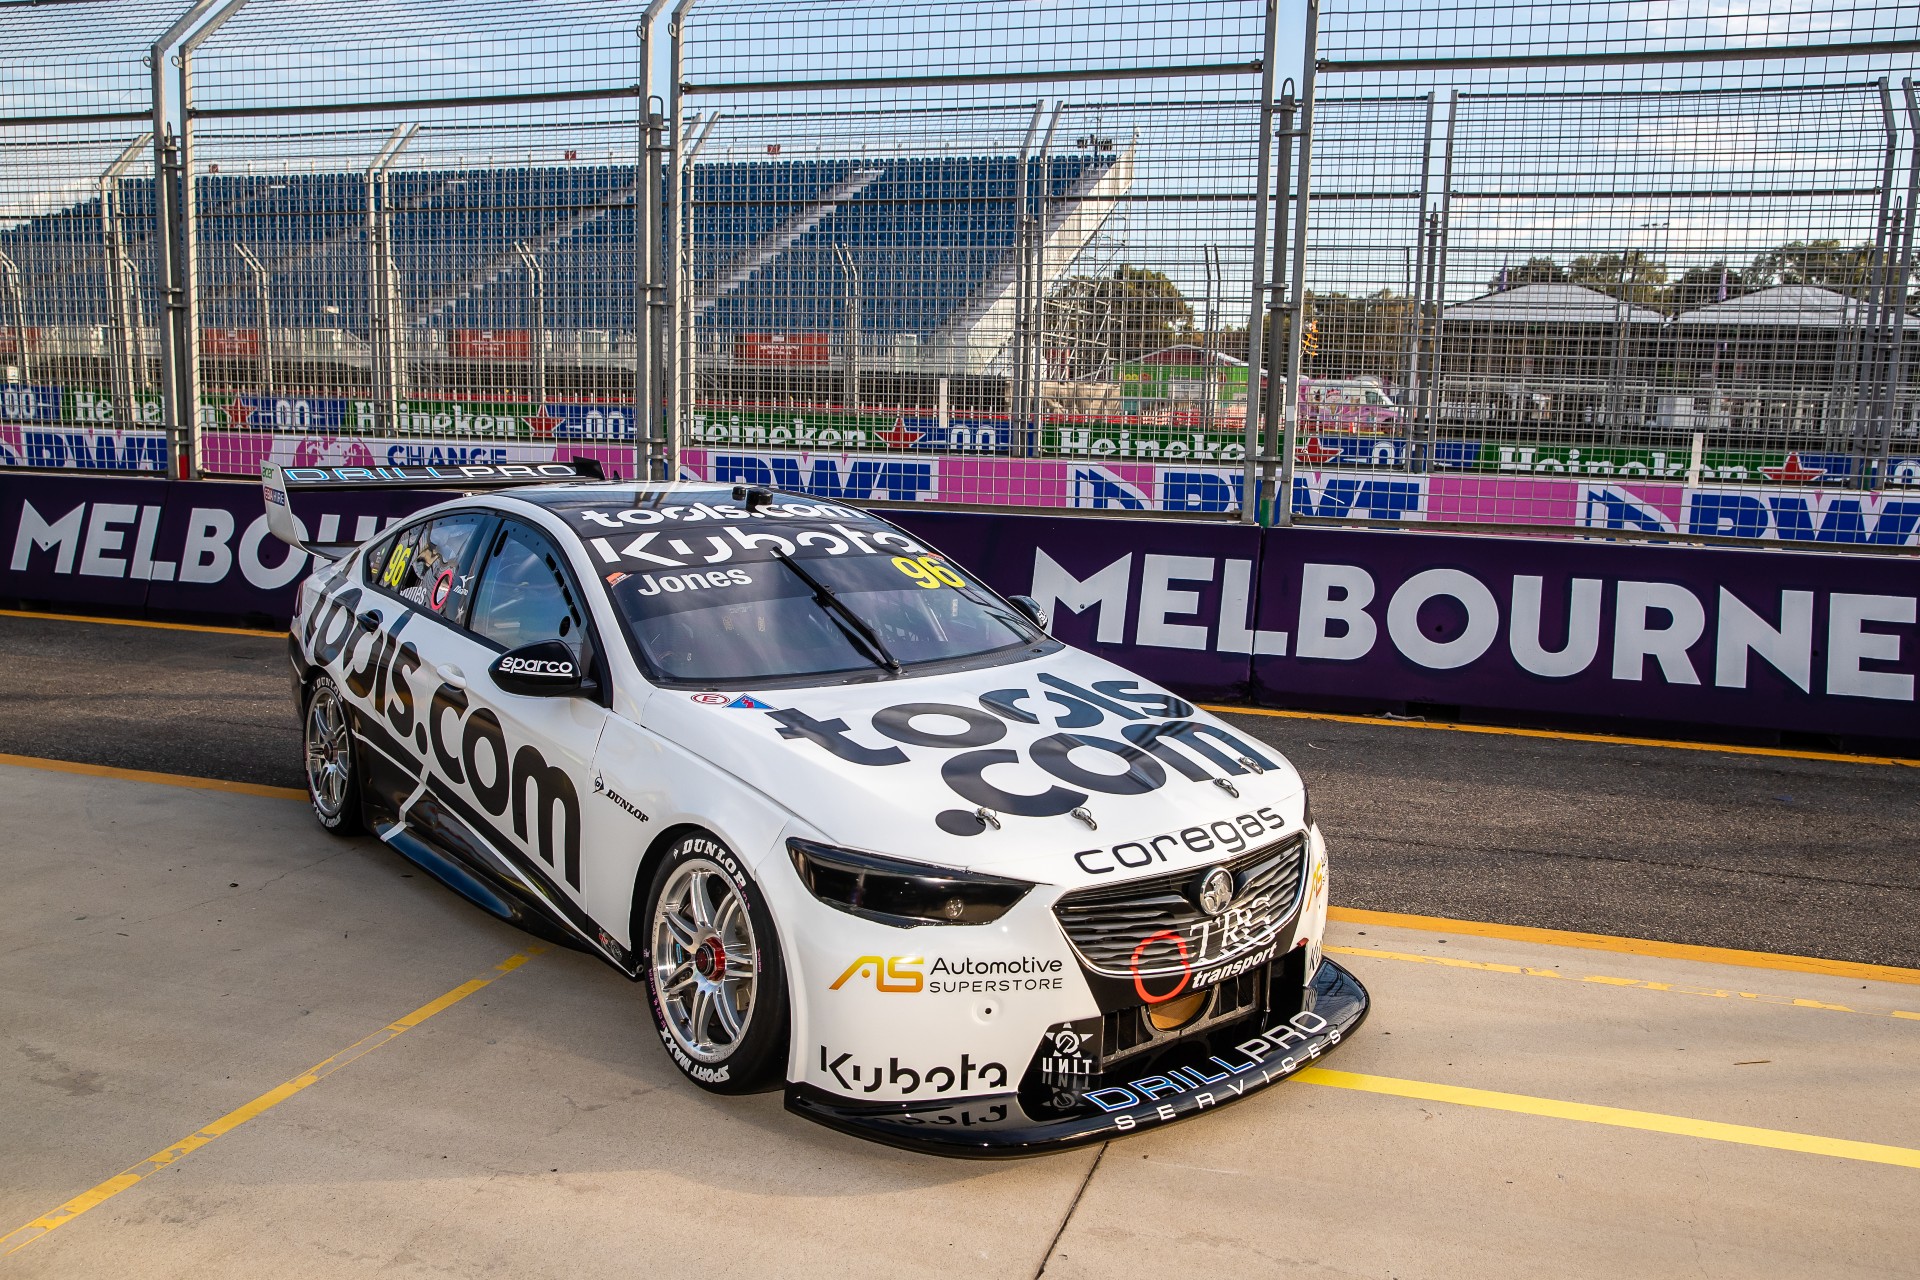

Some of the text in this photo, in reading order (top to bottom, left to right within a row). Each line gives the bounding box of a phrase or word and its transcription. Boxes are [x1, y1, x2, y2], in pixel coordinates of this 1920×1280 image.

[284, 465, 577, 481] DRILLPRO
[384, 544, 411, 587] 96
[590, 523, 929, 567] Kubota
[638, 568, 753, 596] Jones
[890, 554, 966, 589] 96
[1031, 546, 1918, 702] MELBOURNE
[500, 656, 573, 676] sparco
[316, 677, 343, 703] DUNLOP
[764, 672, 1195, 767] tools
[605, 789, 650, 823] DUNLOP
[682, 838, 747, 888] DUNLOP
[1074, 807, 1285, 875] coregas
[929, 977, 1064, 994] SUPERSTORE
[930, 955, 1063, 976] Automotive
[1192, 941, 1278, 989] transport
[660, 1026, 692, 1072] MAXX
[690, 1064, 731, 1083] SPORT
[820, 1044, 1008, 1095] Kubota
[1082, 1010, 1328, 1112] DRILLPRO
[1114, 1029, 1342, 1131] SERVICES
